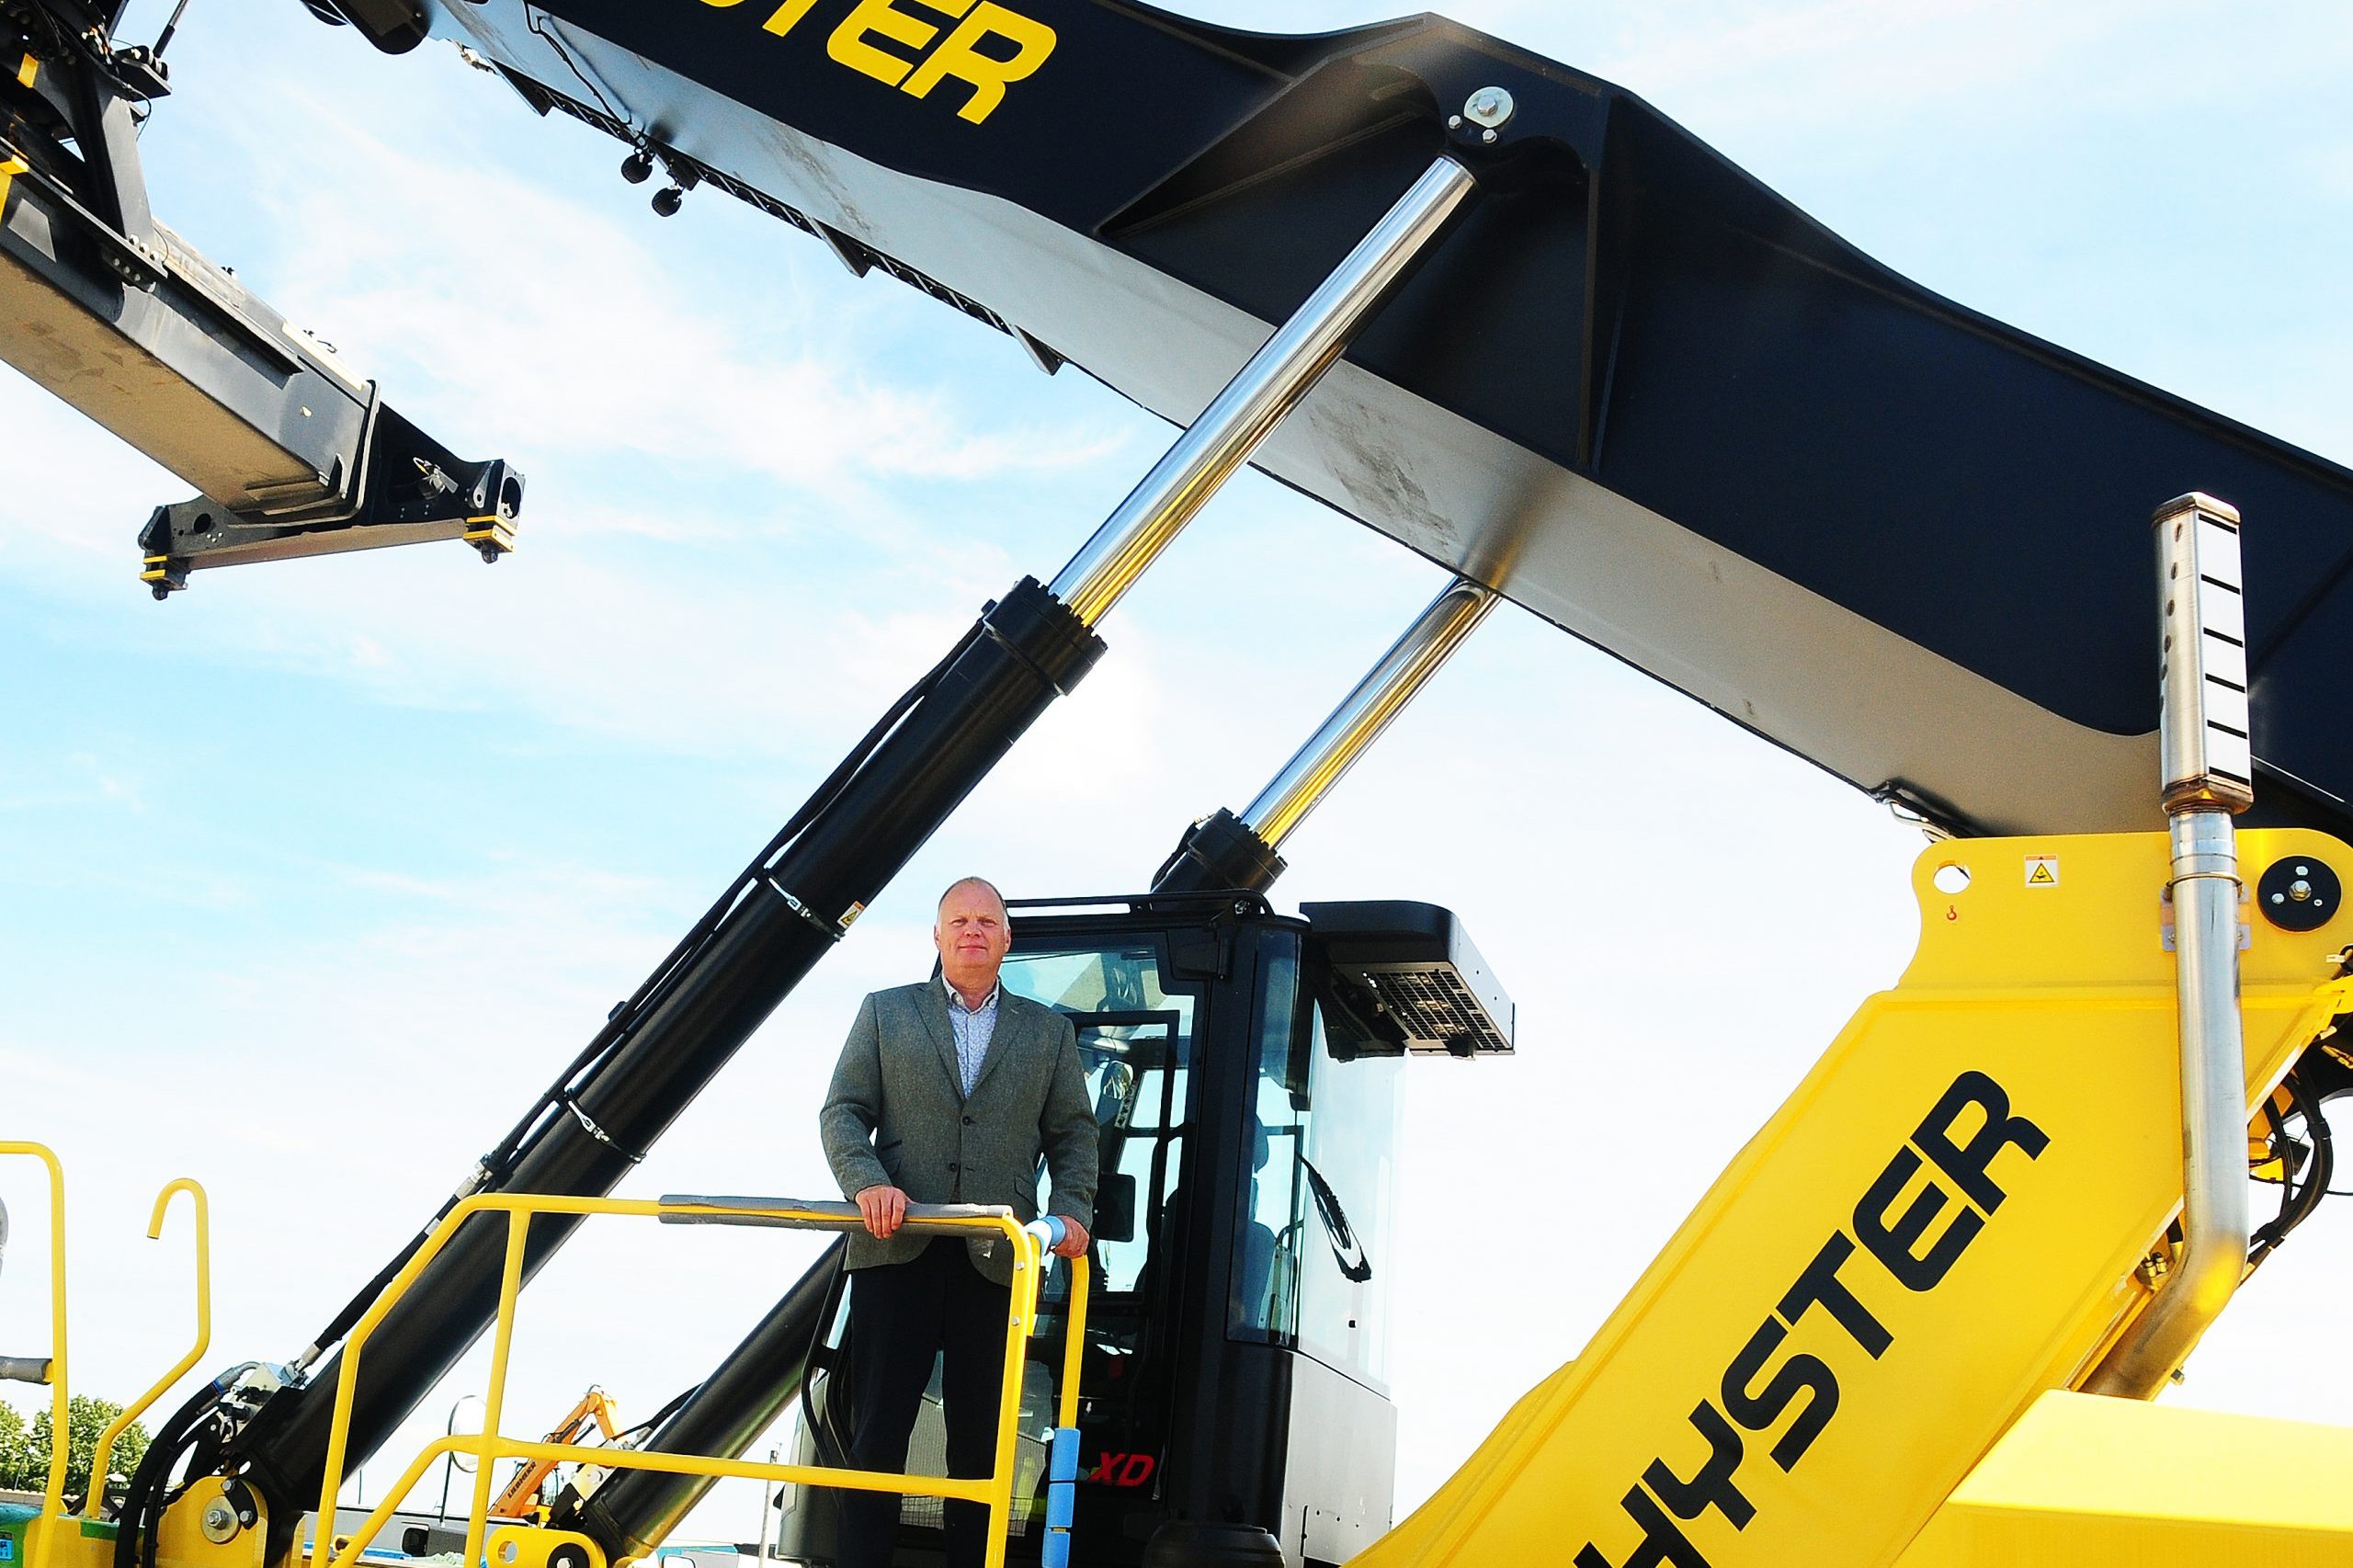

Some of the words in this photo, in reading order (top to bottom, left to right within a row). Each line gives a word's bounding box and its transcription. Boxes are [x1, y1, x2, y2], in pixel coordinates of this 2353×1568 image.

[702, 0, 1057, 125] ER
[1573, 1071, 2052, 1568] HYSTER
[1087, 1452, 1154, 1485] XD
